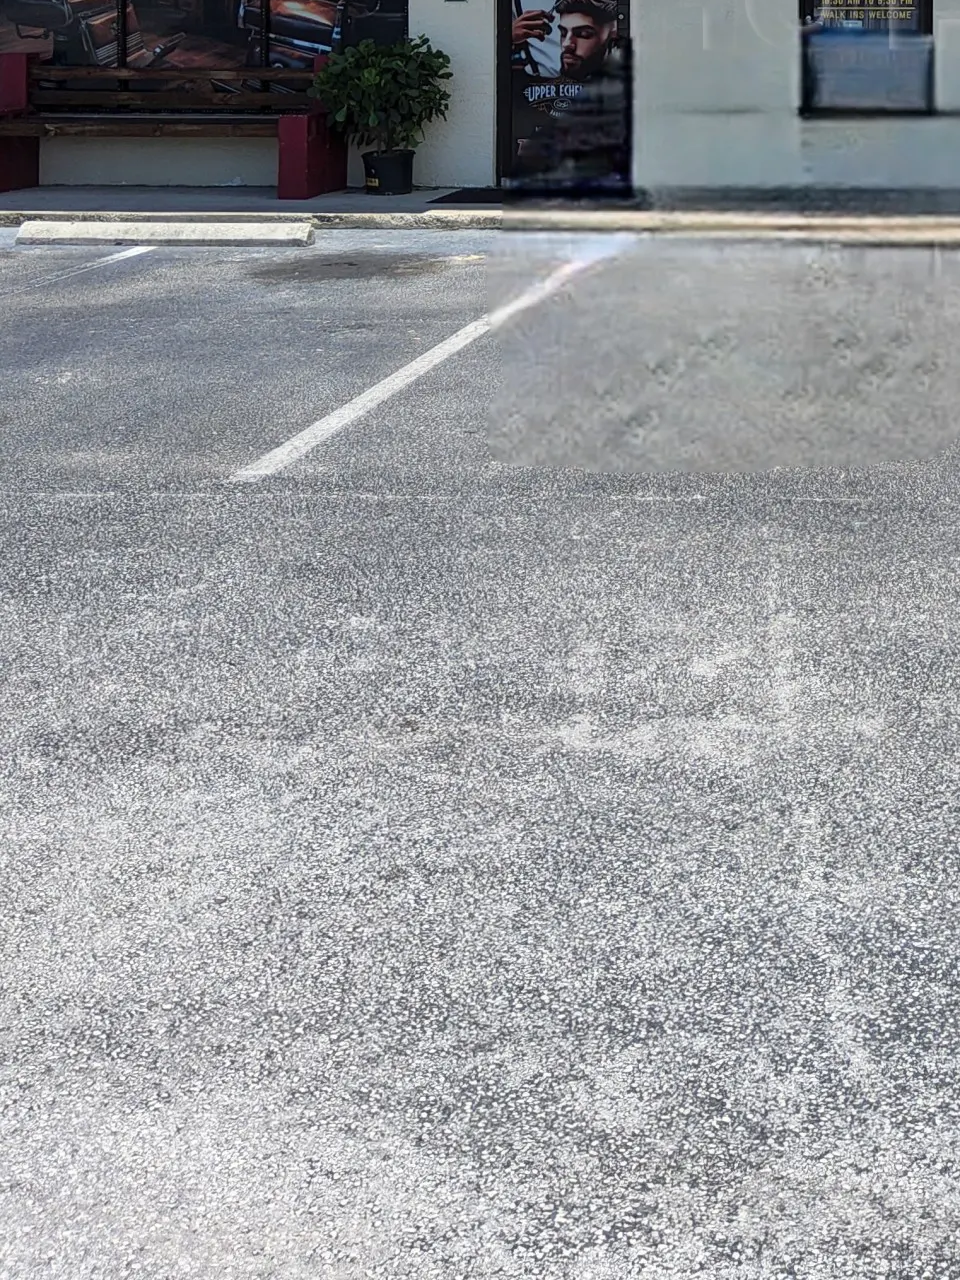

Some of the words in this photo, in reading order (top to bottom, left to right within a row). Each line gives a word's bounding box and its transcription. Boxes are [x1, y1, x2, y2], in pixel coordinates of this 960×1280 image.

[822, 10, 846, 19] WALK
[850, 10, 865, 19] INS
[868, 10, 912, 19] WELCOME
[528, 85, 556, 101] UPPER
